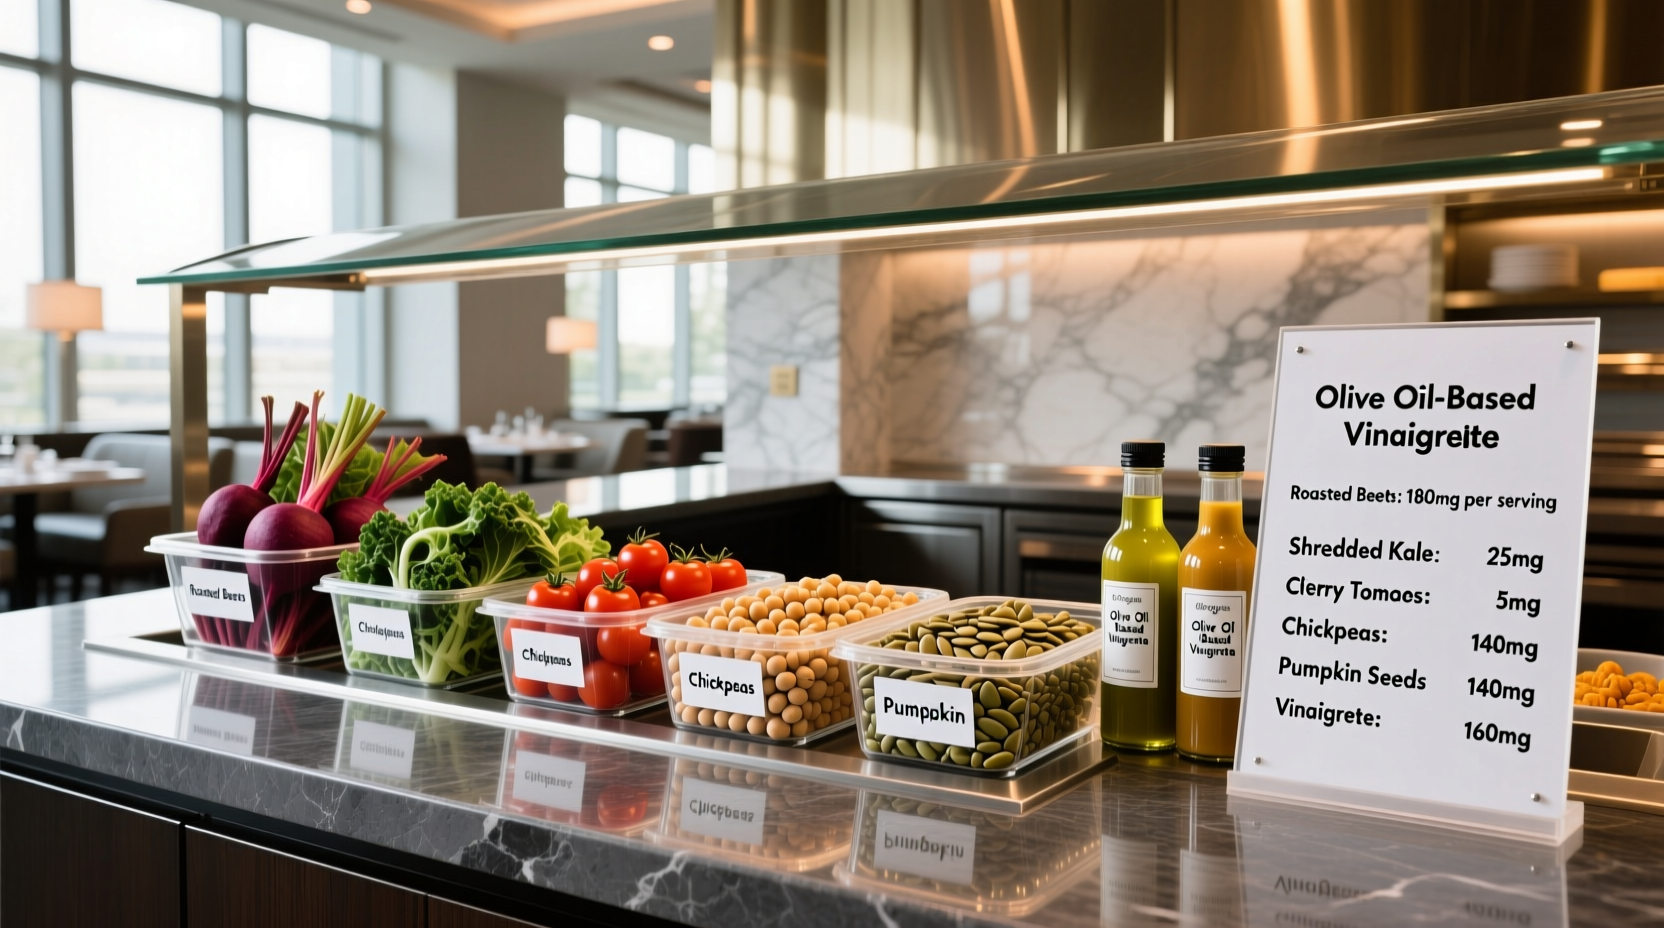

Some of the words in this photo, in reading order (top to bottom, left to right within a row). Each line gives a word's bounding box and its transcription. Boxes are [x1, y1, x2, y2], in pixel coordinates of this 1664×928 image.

[1316, 384, 1385, 409] Olive
[1394, 383, 1536, 410] Oil-Based
[1291, 485, 1352, 501] Roasted
[1357, 487, 1401, 503] Beets:
[1407, 488, 1460, 511] 180mg
[1464, 496, 1492, 511] per
[1497, 493, 1556, 514] serving
[1289, 536, 1383, 559] Shredded
[1389, 541, 1439, 562] Kale:
[1487, 547, 1543, 574] 25mg
[1286, 576, 1344, 603] Clerry
[1496, 590, 1540, 618] 5mg
[1282, 616, 1387, 644] Chickpeas:
[1472, 634, 1538, 662] 140mg
[689, 672, 754, 696] Chickpeas
[1279, 656, 1361, 685] Pumpkin
[1368, 666, 1426, 690] Seeds
[1468, 677, 1534, 707] 140mg
[1276, 697, 1380, 727] Vinaigrete:
[1465, 722, 1531, 753] 160mg
